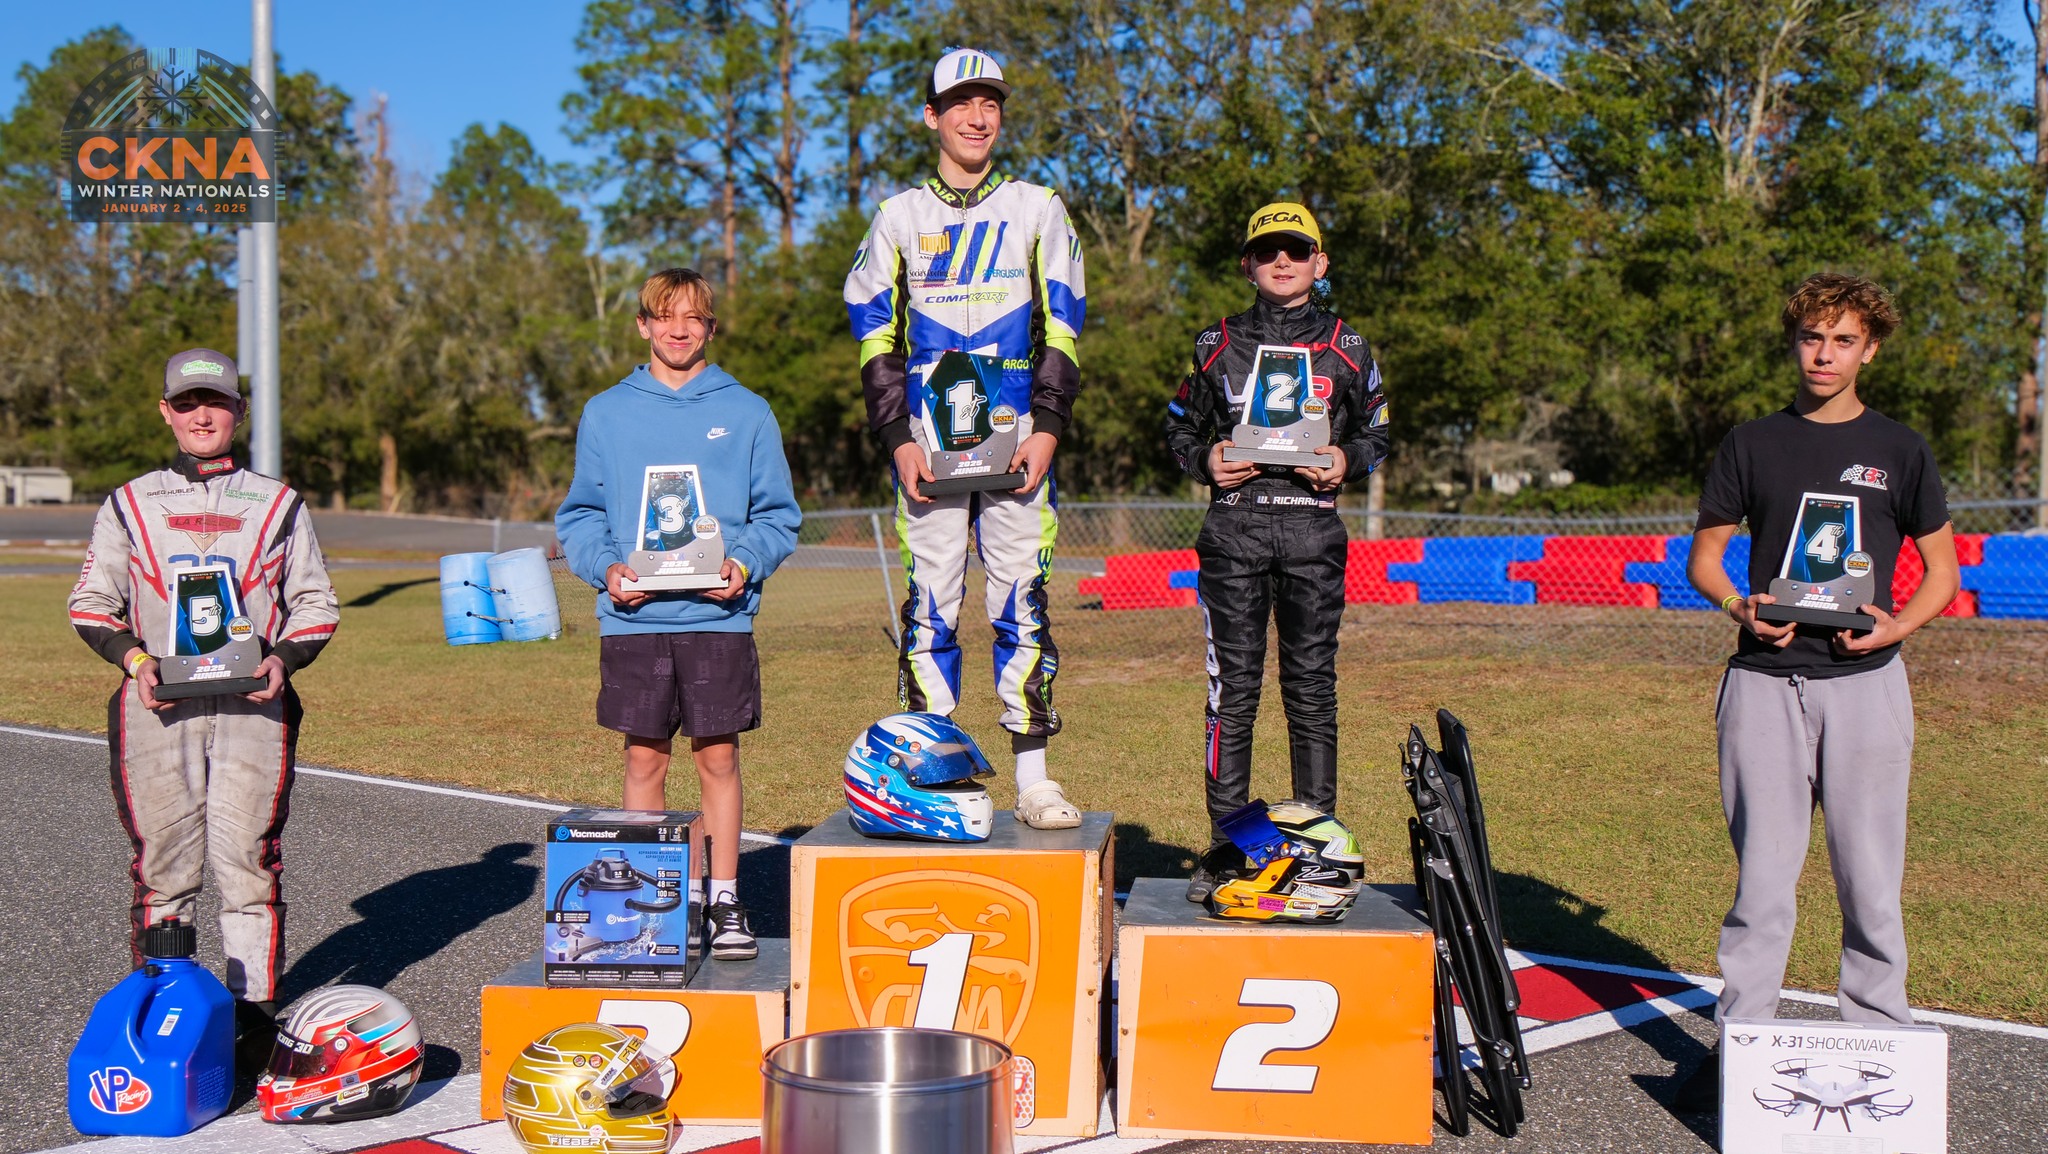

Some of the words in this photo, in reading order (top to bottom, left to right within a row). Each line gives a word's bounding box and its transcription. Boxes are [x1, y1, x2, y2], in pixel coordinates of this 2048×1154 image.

[1252, 212, 1304, 235] VEGA
[990, 268, 1025, 278] FERGUSON
[924, 292, 1009, 304] COMPKART
[1197, 331, 1221, 345] K1
[1341, 334, 1363, 349] K1
[710, 427, 726, 435] NIKE
[1264, 437, 1295, 446] 2025
[958, 460, 983, 468] 2025
[950, 466, 991, 476] JUNIOR
[146, 489, 166, 497] GREG
[167, 487, 195, 496] HUBLER
[1256, 495, 1270, 505] W.
[175, 518, 190, 526] LA
[654, 567, 695, 575] JUNIOR
[1802, 593, 1835, 603] 2025
[1795, 599, 1840, 610] JUNIOR
[195, 664, 226, 673] 2025
[188, 671, 232, 681] JUNIOR
[569, 829, 618, 838] Vacmaster
[658, 827, 668, 835] 2.5
[657, 870, 666, 878] 55
[656, 880, 666, 888] 48
[555, 912, 561, 922] 6
[649, 941, 657, 957] 2
[908, 933, 975, 1030] 1
[1211, 978, 1341, 1094] 2
[294, 1040, 314, 1055] 30
[1771, 1034, 1803, 1048] X-31
[1806, 1036, 1896, 1053] SHOCKWAVE
[89, 1066, 132, 1112] VP
[118, 1089, 150, 1107] Racing
[550, 1136, 601, 1146] FIEBER
